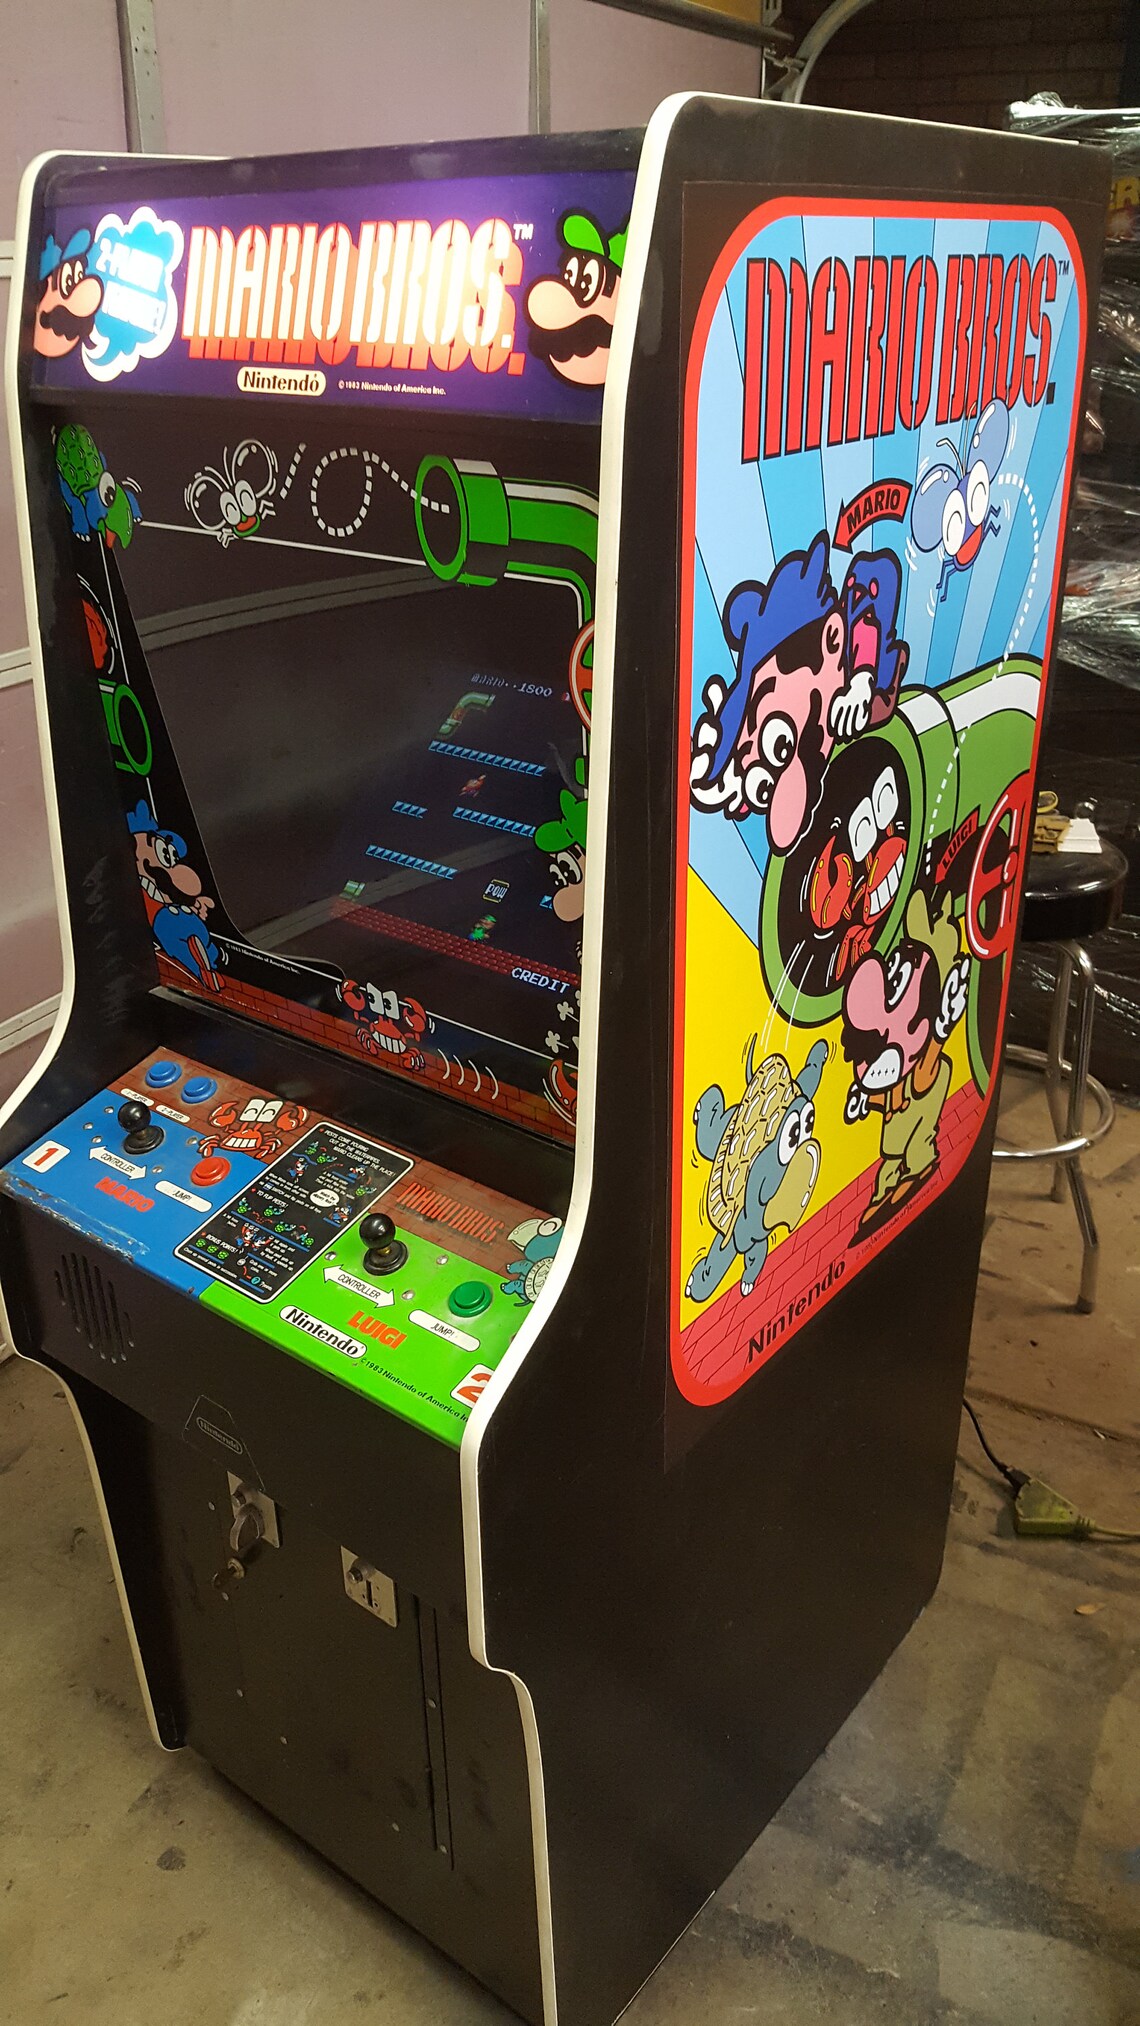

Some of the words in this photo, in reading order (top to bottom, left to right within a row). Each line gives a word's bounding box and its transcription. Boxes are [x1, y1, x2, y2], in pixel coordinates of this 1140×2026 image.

[182, 222, 353, 364] MARIO
[350, 218, 525, 375] BROS.
[742, 255, 938, 464] MARIO
[935, 254, 1056, 426] BROS.
[243, 370, 320, 393] Nintendo
[361, 381, 392, 392] Nintendo
[393, 383, 401, 393] of
[401, 383, 432, 395] America
[433, 385, 446, 396] Inc.
[846, 492, 900, 534] MARIO
[942, 819, 973, 869] LUIGI
[485, 883, 508, 899] POW
[511, 967, 570, 994] CREDIT
[34, 1147, 59, 1166] 1
[100, 1152, 136, 1174] CONTROLLER
[94, 1176, 155, 1213] MARIO
[396, 1182, 461, 1223] MARIO
[338, 1272, 381, 1301] CONTROLLER
[430, 1322, 455, 1337] JUMP!
[748, 1258, 846, 1364] Nintendo
[285, 1307, 359, 1357] Nintendo
[347, 1310, 408, 1350] LUIGI
[383, 1370, 417, 1393] Nintendo
[417, 1390, 427, 1398] of
[426, 1395, 460, 1418] America
[457, 1373, 495, 1403] 2
